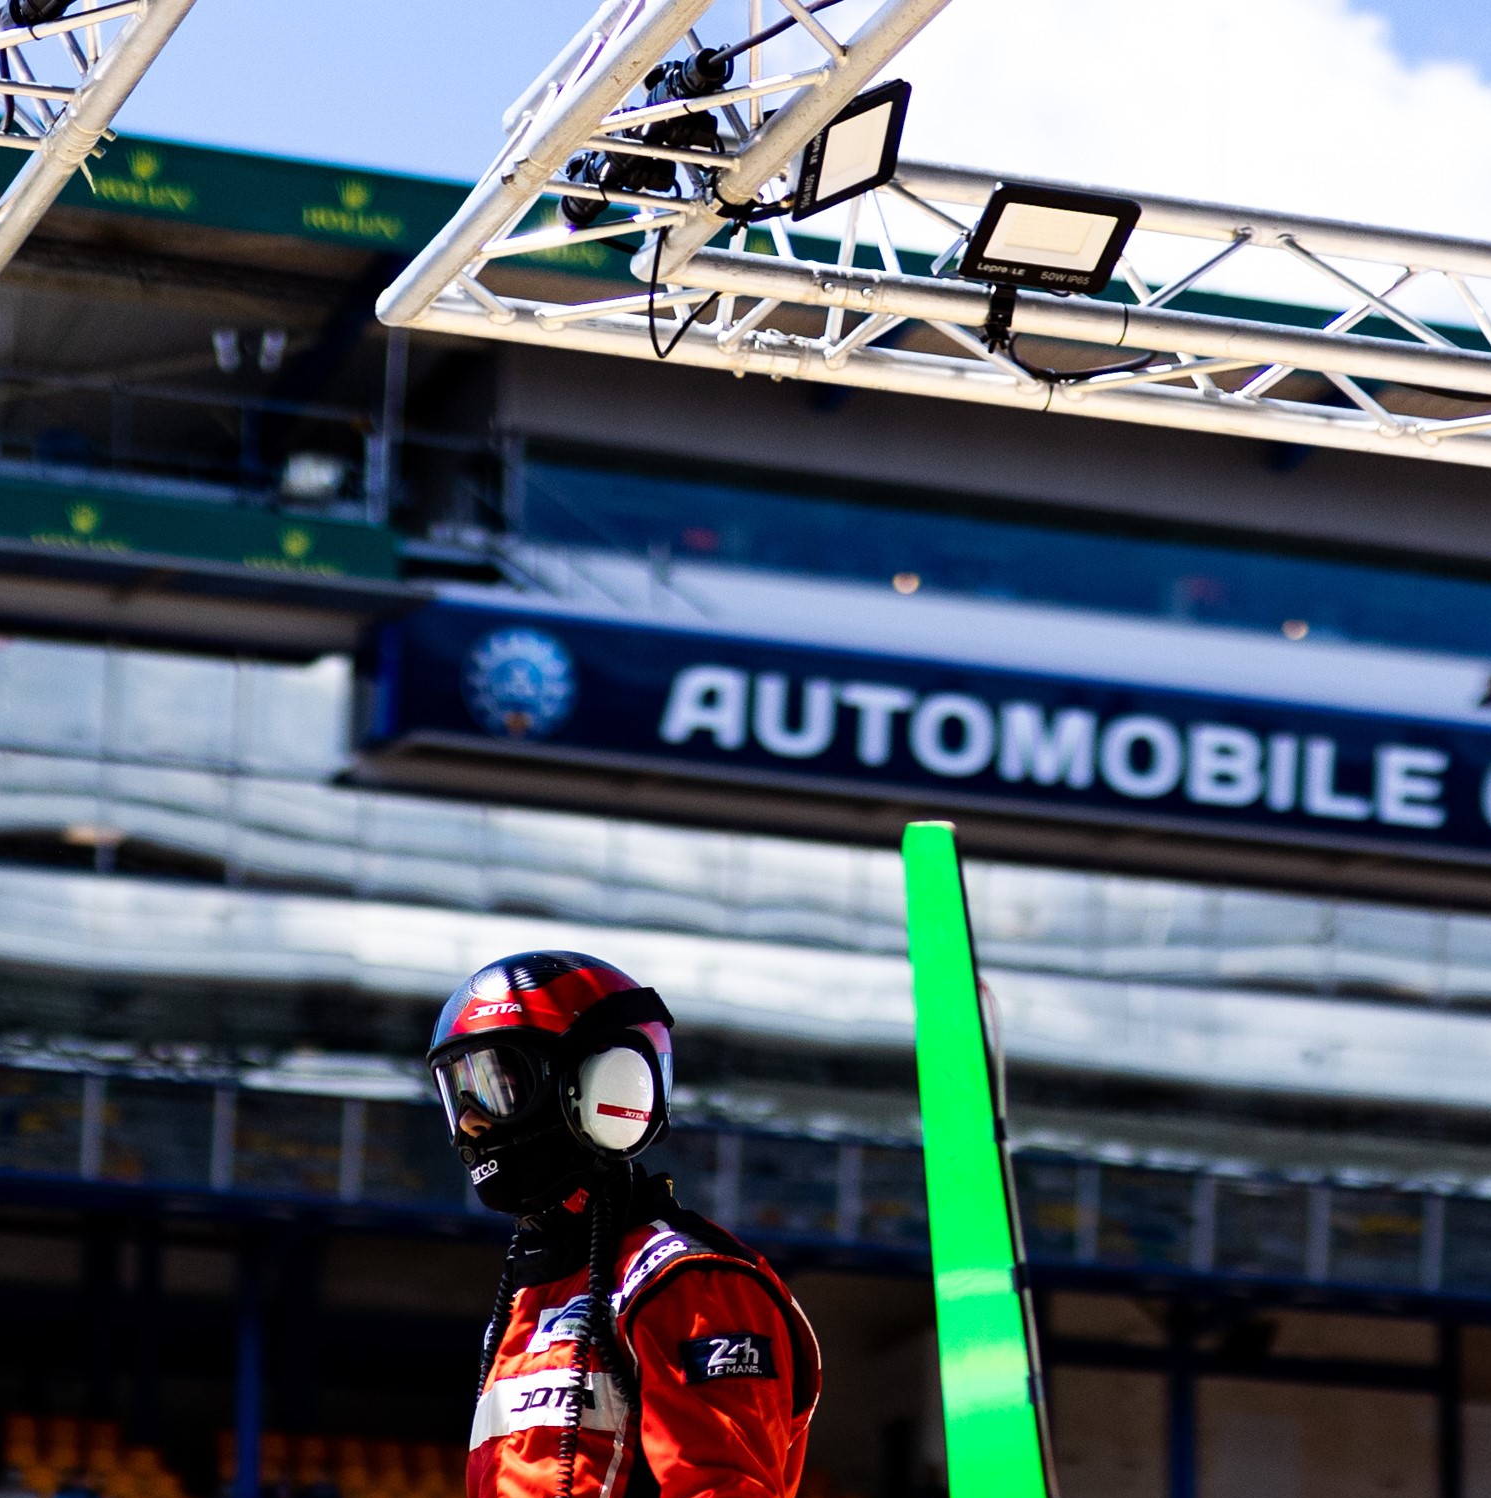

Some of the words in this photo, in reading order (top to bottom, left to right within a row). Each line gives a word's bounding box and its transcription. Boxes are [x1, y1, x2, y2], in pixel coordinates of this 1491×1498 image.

[659, 663, 1449, 828] AUTOMOBILE
[468, 1002, 523, 1020] JOTA
[707, 1366, 723, 1376] LE
